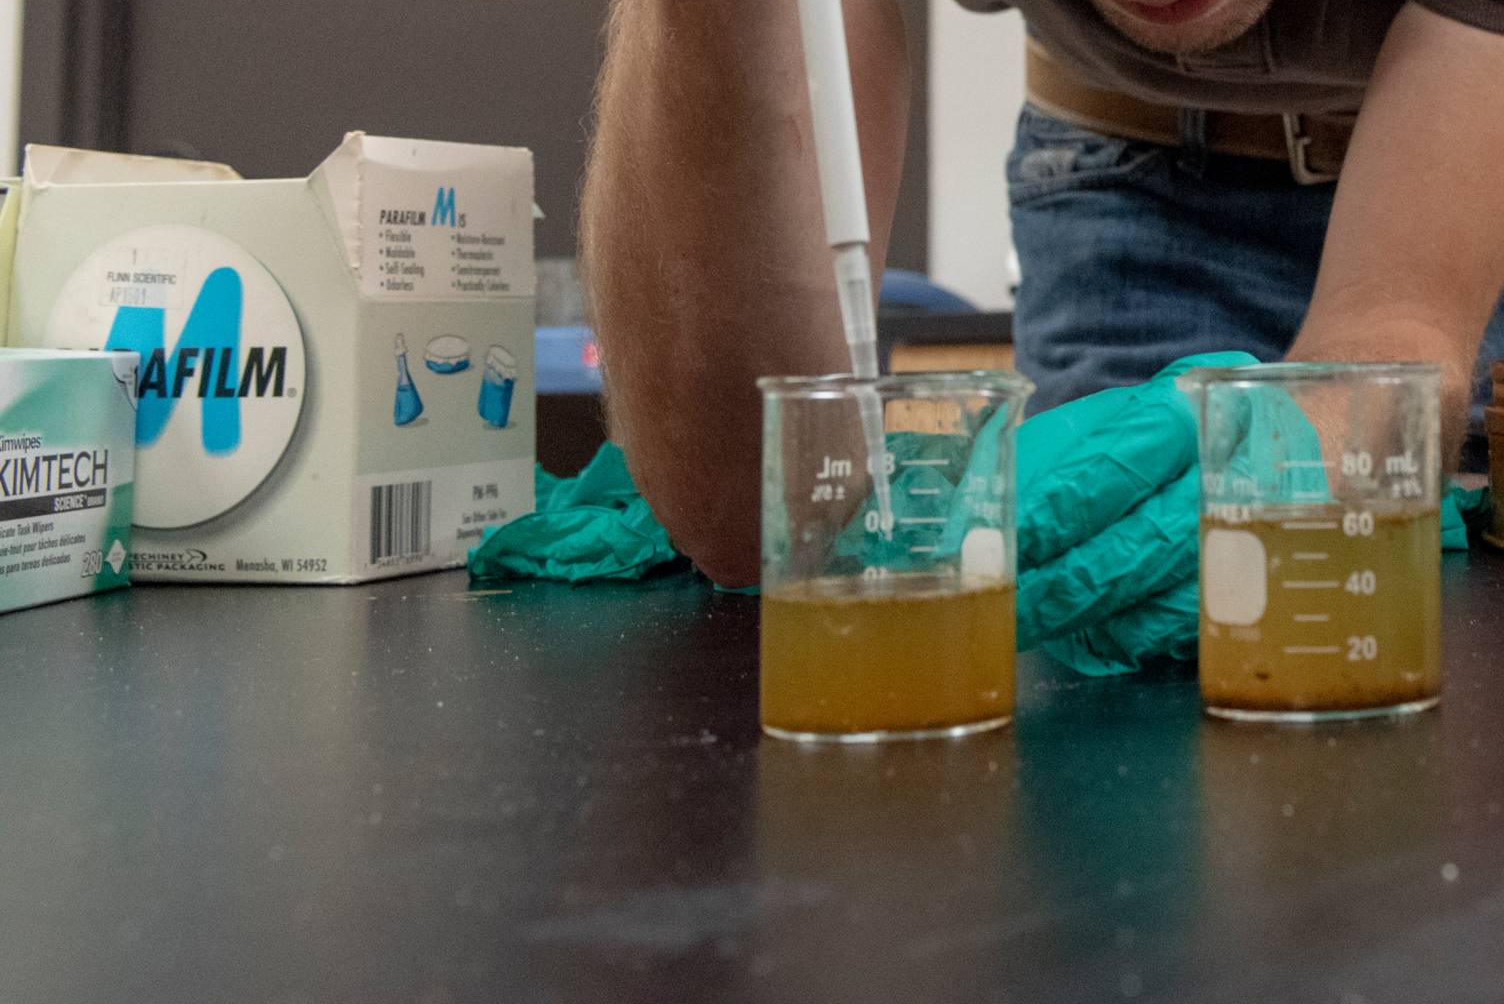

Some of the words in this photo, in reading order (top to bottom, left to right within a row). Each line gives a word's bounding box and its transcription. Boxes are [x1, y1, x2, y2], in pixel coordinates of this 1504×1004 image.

[432, 186, 456, 228] M
[107, 271, 131, 283] FLINN
[133, 272, 177, 285] SCIENTIFIC
[57, 346, 288, 398] AFILM
[1342, 451, 1374, 477] 80
[1385, 451, 1419, 476] mL
[32, 520, 55, 536] Wipers
[1342, 510, 1376, 537] 60
[127, 562, 153, 571] STIC
[157, 562, 226, 572] PACKAGING
[281, 559, 294, 572] WI
[297, 559, 328, 573] 54952
[1344, 570, 1378, 597] 40
[1346, 635, 1379, 662] 20
